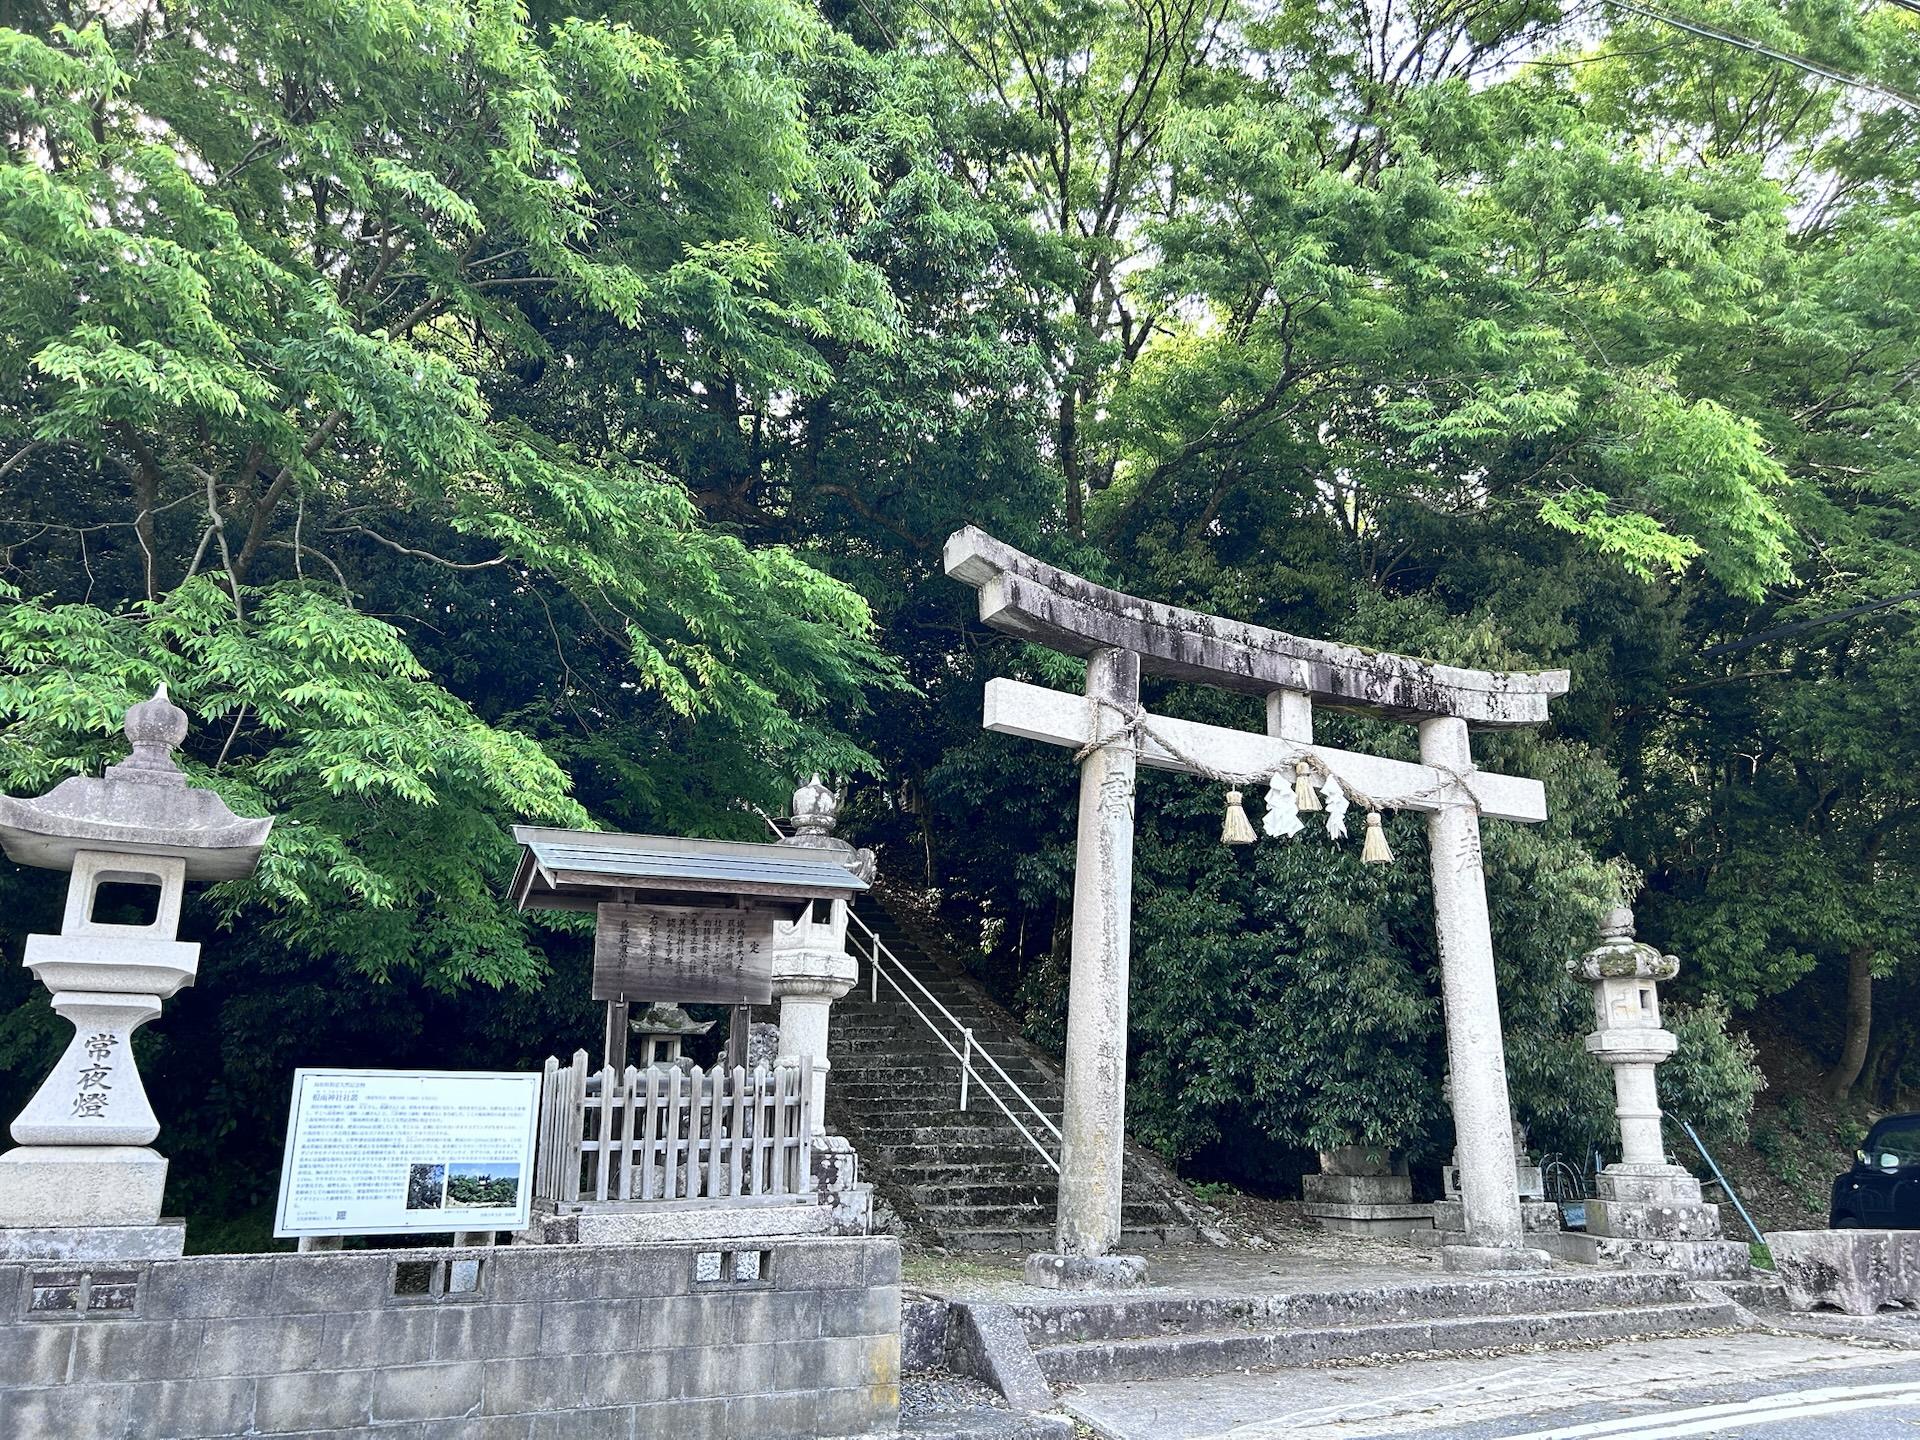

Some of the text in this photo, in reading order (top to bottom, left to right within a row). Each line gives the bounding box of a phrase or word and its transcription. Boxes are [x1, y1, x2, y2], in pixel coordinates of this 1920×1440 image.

[749, 940, 760, 954] 定
[70, 1032, 120, 1119] 常夜燈
